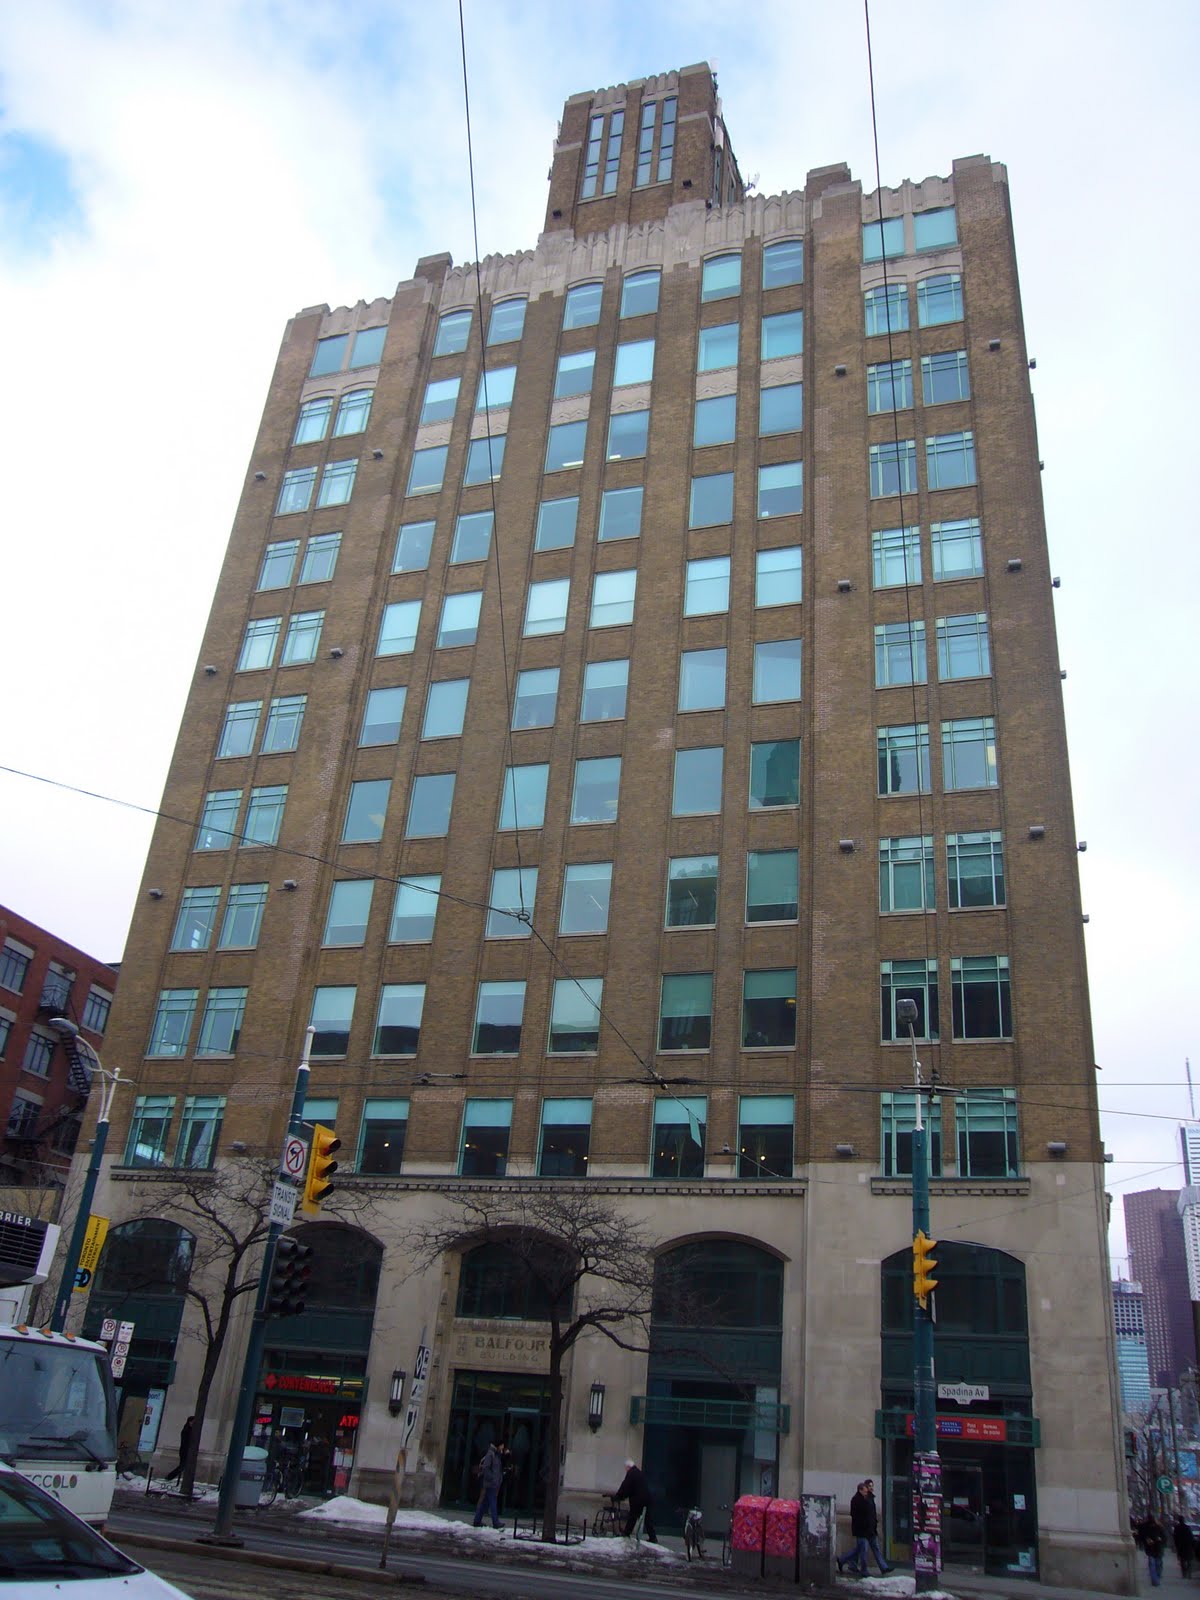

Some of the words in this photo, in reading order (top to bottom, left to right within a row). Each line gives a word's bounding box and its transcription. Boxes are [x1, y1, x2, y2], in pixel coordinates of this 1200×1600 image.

[275, 1186, 296, 1205] TRANSIT
[273, 1203, 291, 1220] SIGNAL
[80, 1238, 91, 1265] TORONTO
[85, 1219, 101, 1267] ENTERTAINMENT
[89, 1243, 99, 1268] DISTRICT
[475, 1336, 546, 1352] BALFOUR
[480, 1350, 538, 1361] BUILDING
[278, 1376, 336, 1393] CONVENIENCE
[942, 1386, 973, 1398] Spadina
[974, 1388, 985, 1398] Av
[24, 1474, 78, 1489] CCOLO
